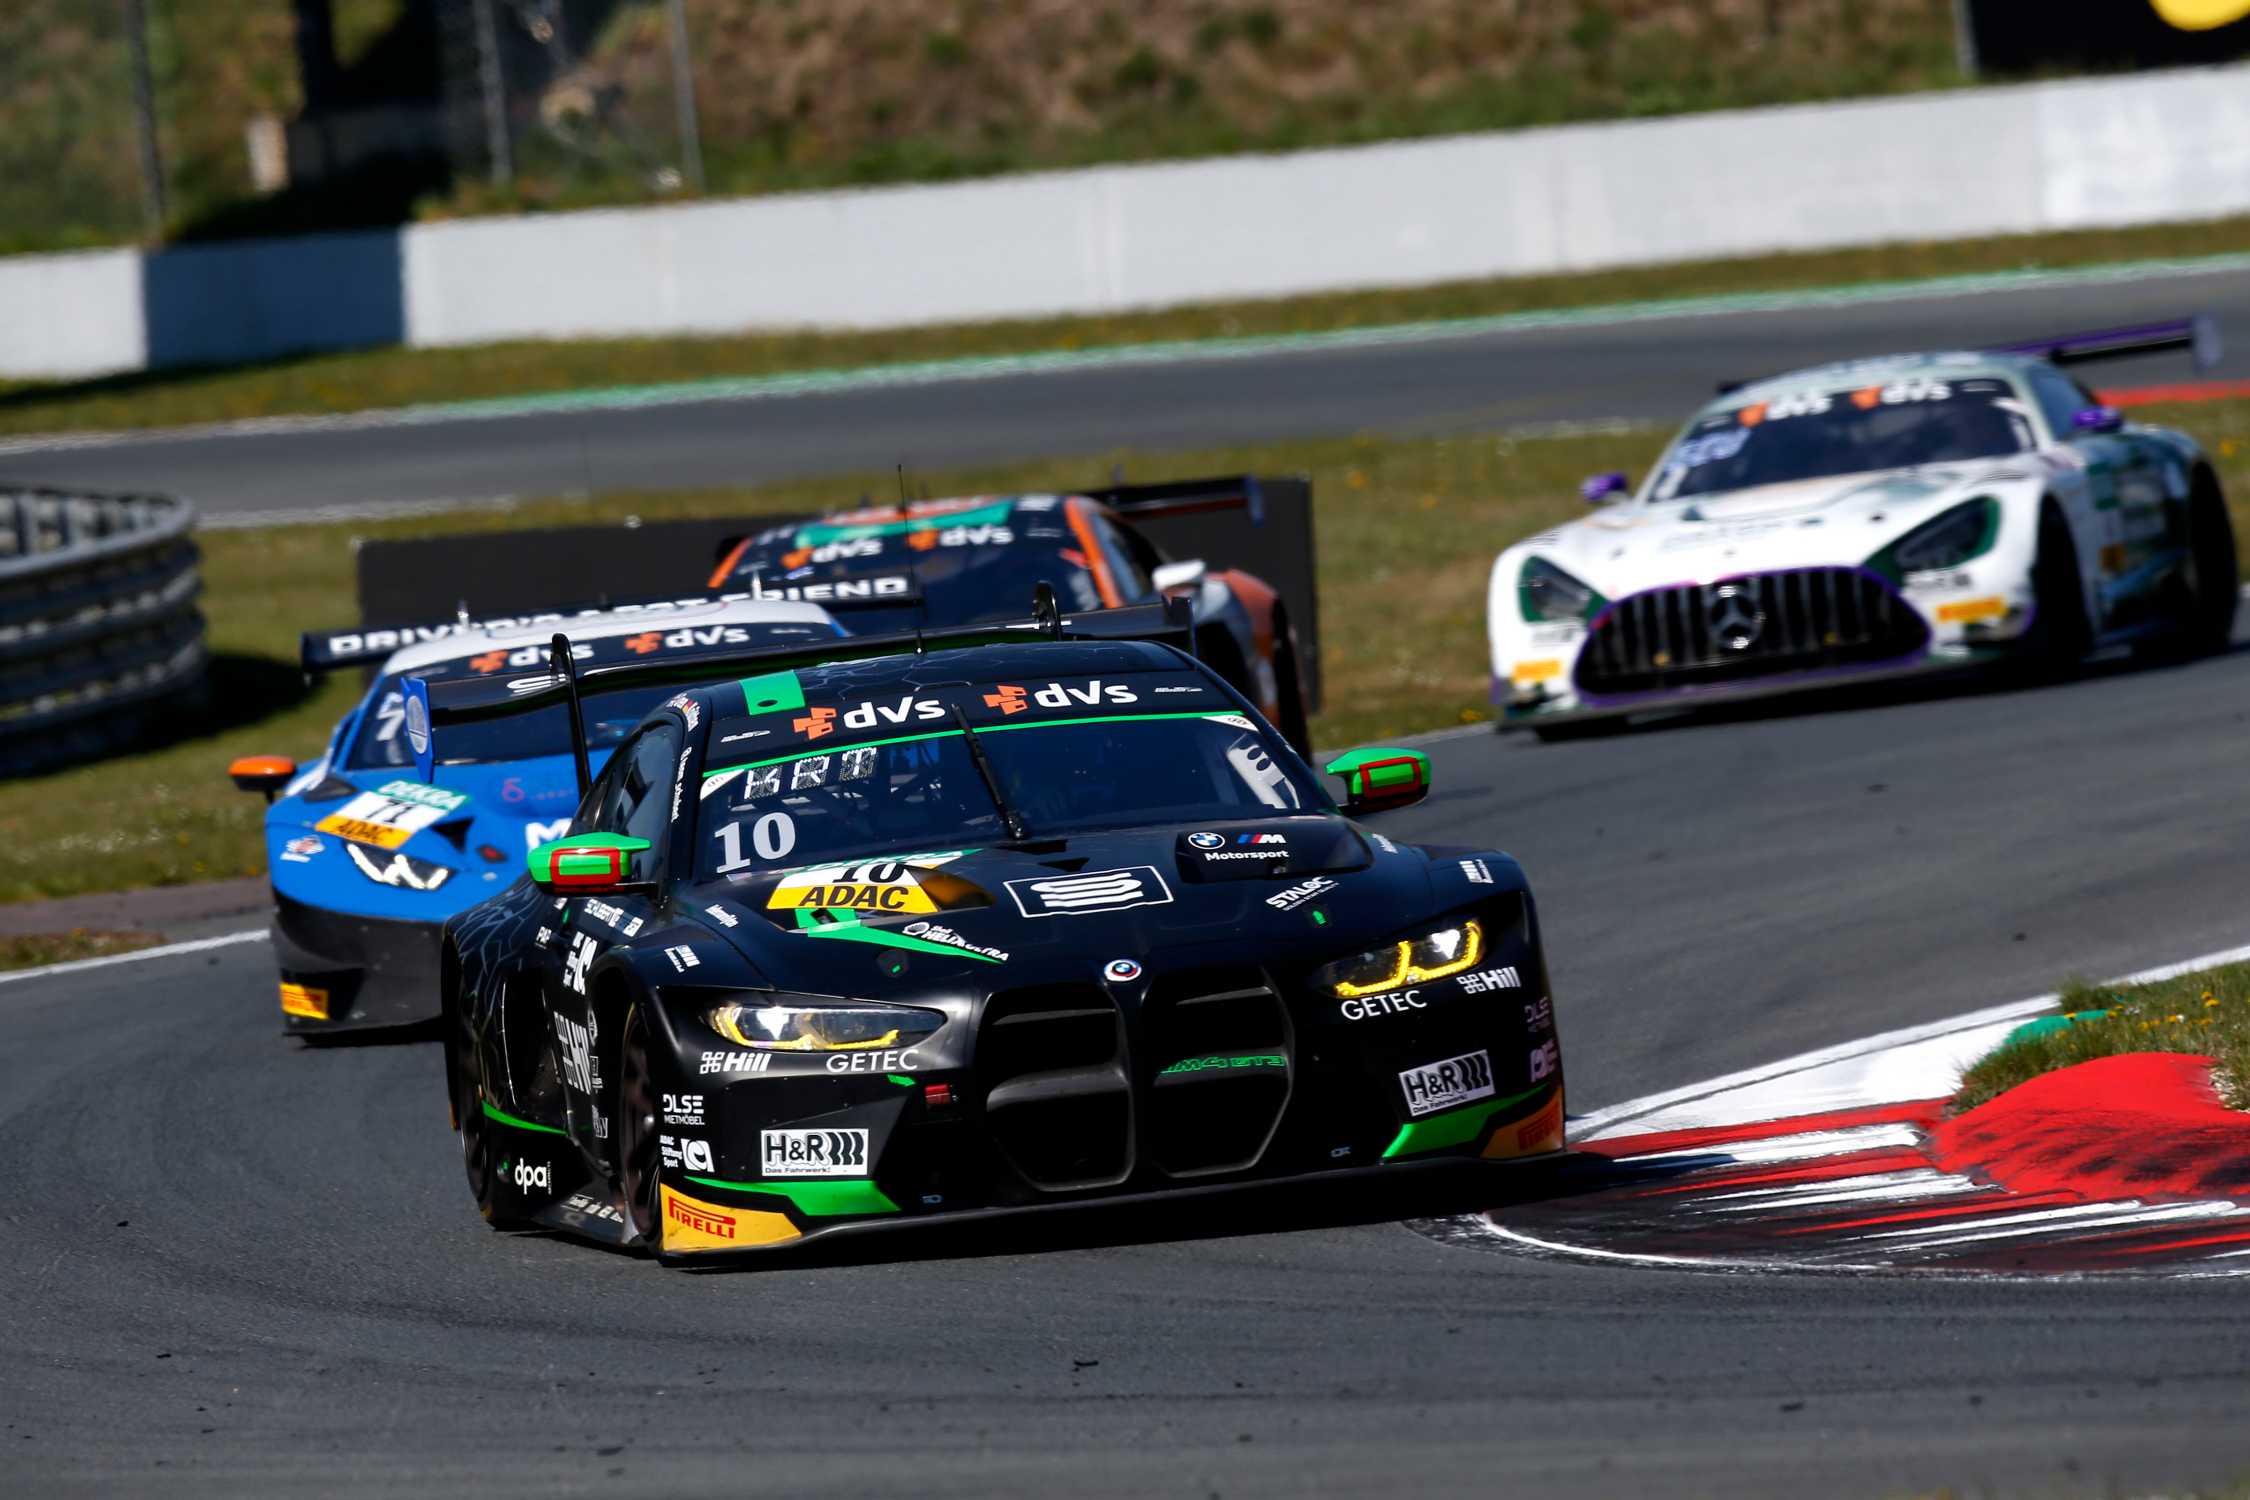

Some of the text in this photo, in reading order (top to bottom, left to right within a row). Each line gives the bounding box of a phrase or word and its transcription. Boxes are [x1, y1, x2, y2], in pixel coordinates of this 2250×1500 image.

[665, 626, 750, 648] dvs
[1034, 681, 1138, 708] dvs
[844, 697, 946, 729] dvs
[714, 812, 796, 873] 10
[1204, 850, 1290, 861] Motorsport
[798, 885, 909, 909] ADAC
[1265, 876, 1334, 908] STALOC
[1341, 990, 1427, 1020] GETEC
[723, 1052, 772, 1072] Hill
[826, 1050, 919, 1073] GETEC
[766, 1134, 825, 1162] H&R
[514, 1157, 547, 1195] dpa
[668, 1195, 737, 1239] PIRELLI
